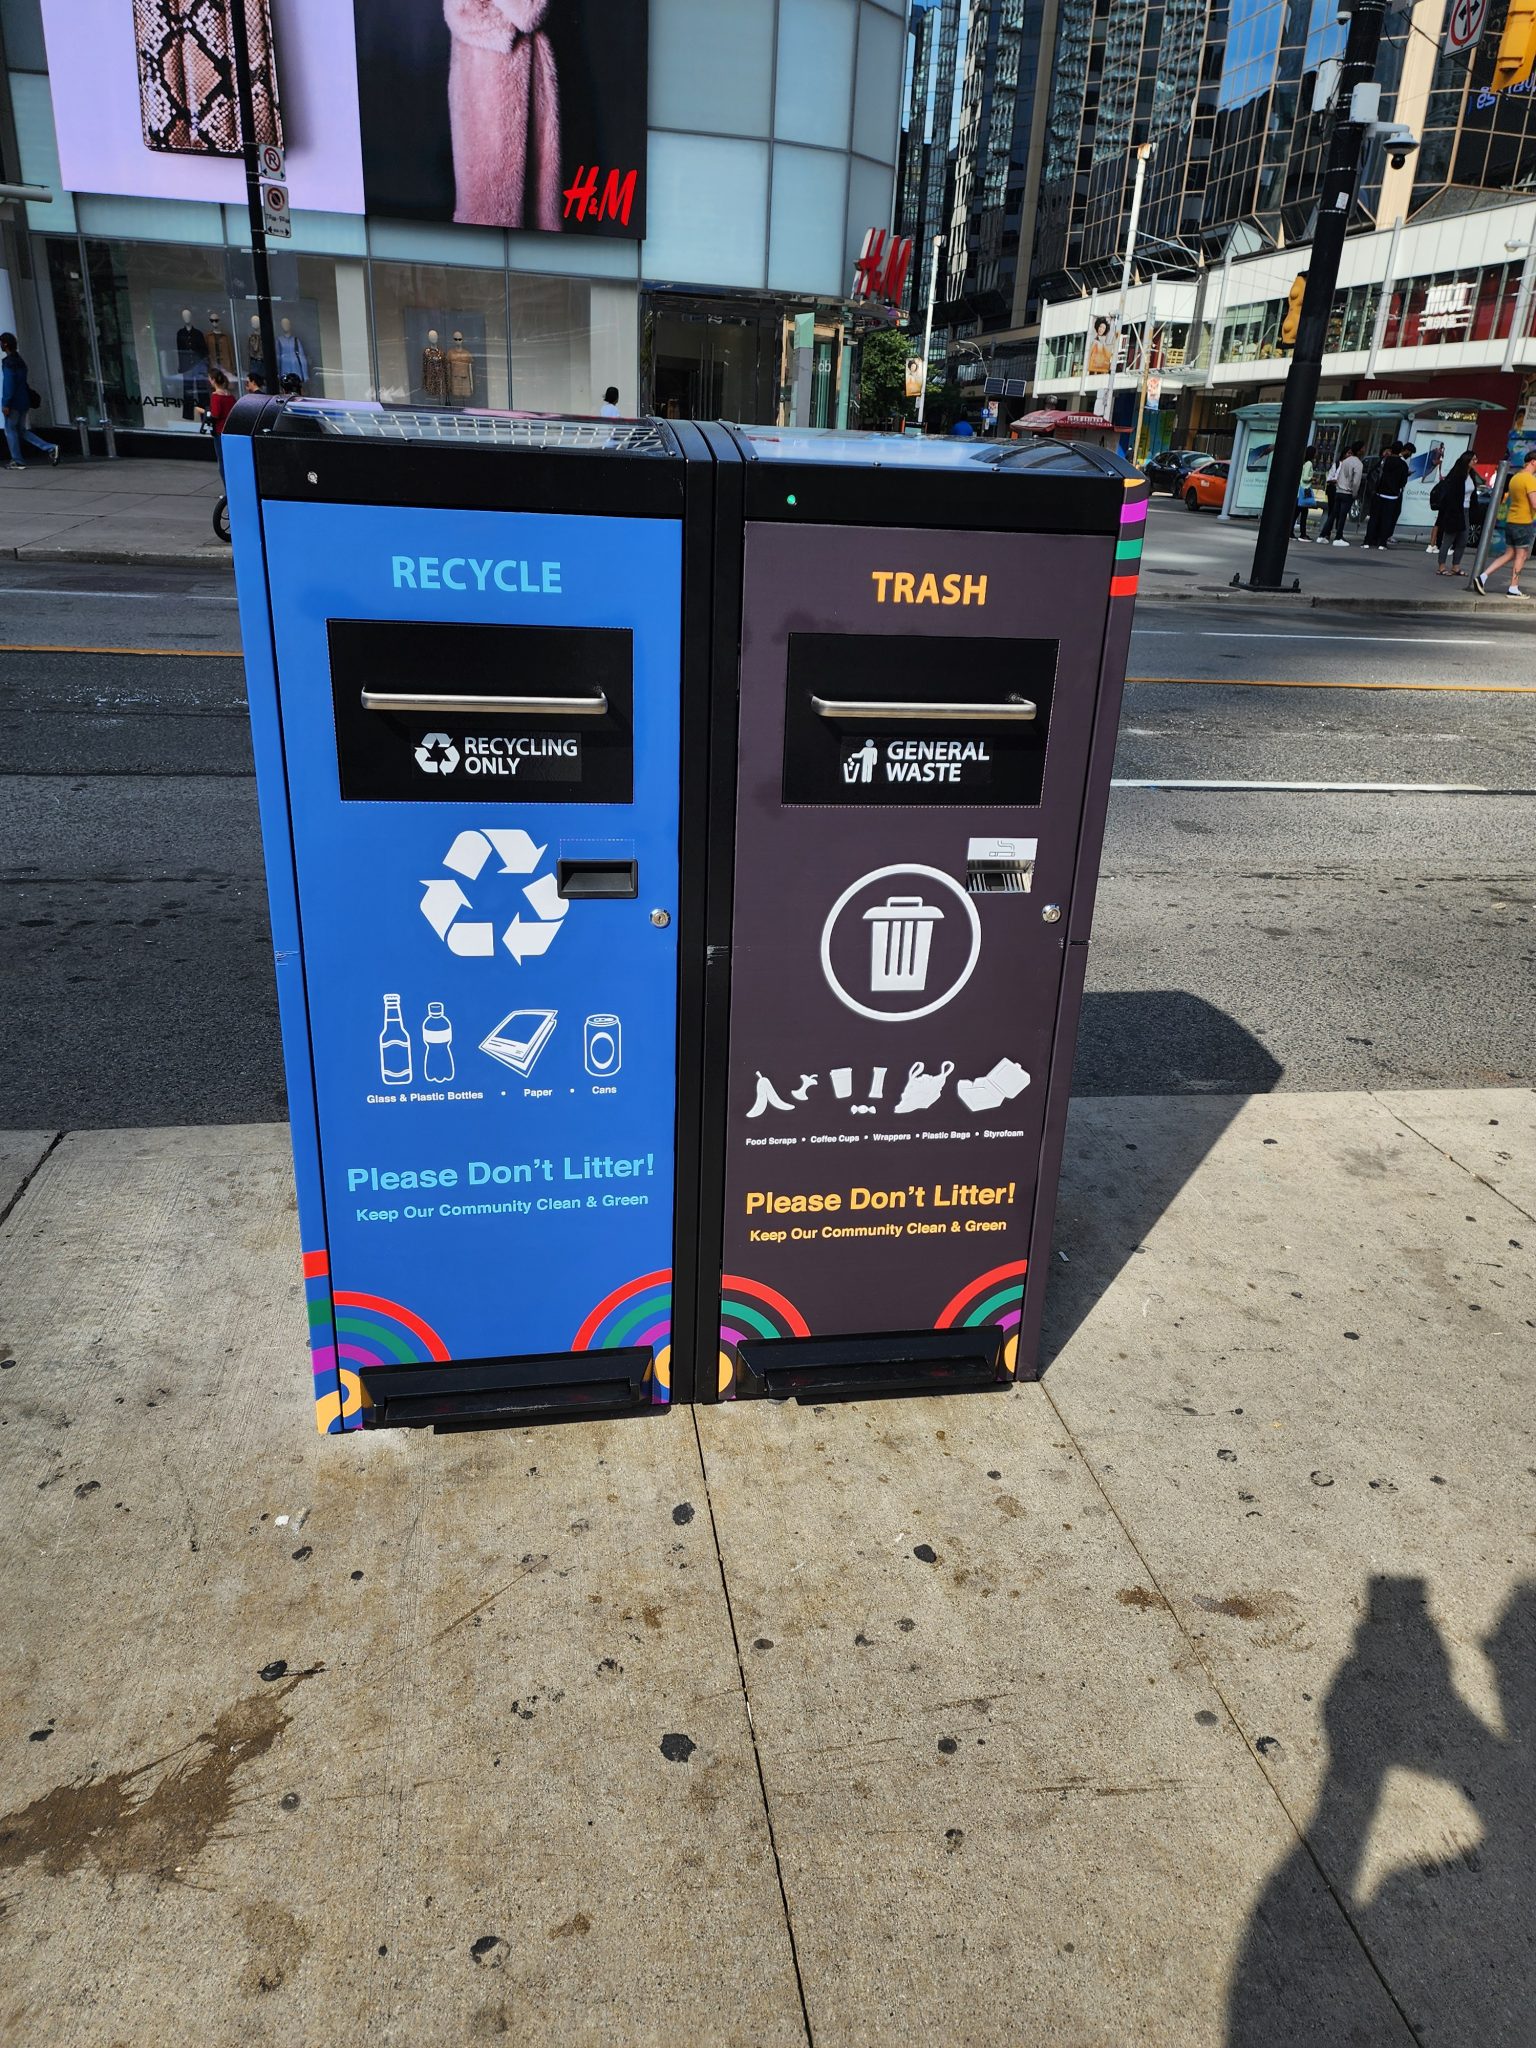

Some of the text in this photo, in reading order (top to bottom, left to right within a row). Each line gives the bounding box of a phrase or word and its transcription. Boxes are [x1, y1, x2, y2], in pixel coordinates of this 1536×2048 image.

[563, 165, 638, 226] H&M
[852, 227, 912, 305] H&M
[392, 556, 562, 593] RECYCLE
[872, 572, 987, 605] TRASH
[465, 737, 577, 757] RECYCLING
[888, 741, 989, 760] GENERAL
[465, 756, 520, 775] ONLY
[886, 763, 961, 782] WASTE
[366, 1085, 617, 1104] Glass & Plastic Bottles Paper Cans
[745, 1129, 1024, 1146] Food Scraps Coffee Cups Wrappers Plastic Bags Styrofoam
[348, 1154, 653, 1191] Please Don’t Litter!
[356, 1194, 649, 1223] Keep Our Community Clean & Green
[747, 1183, 1015, 1214] Please Don’t Litter!
[749, 1219, 1007, 1244] Keep Our Community Clean & Green
